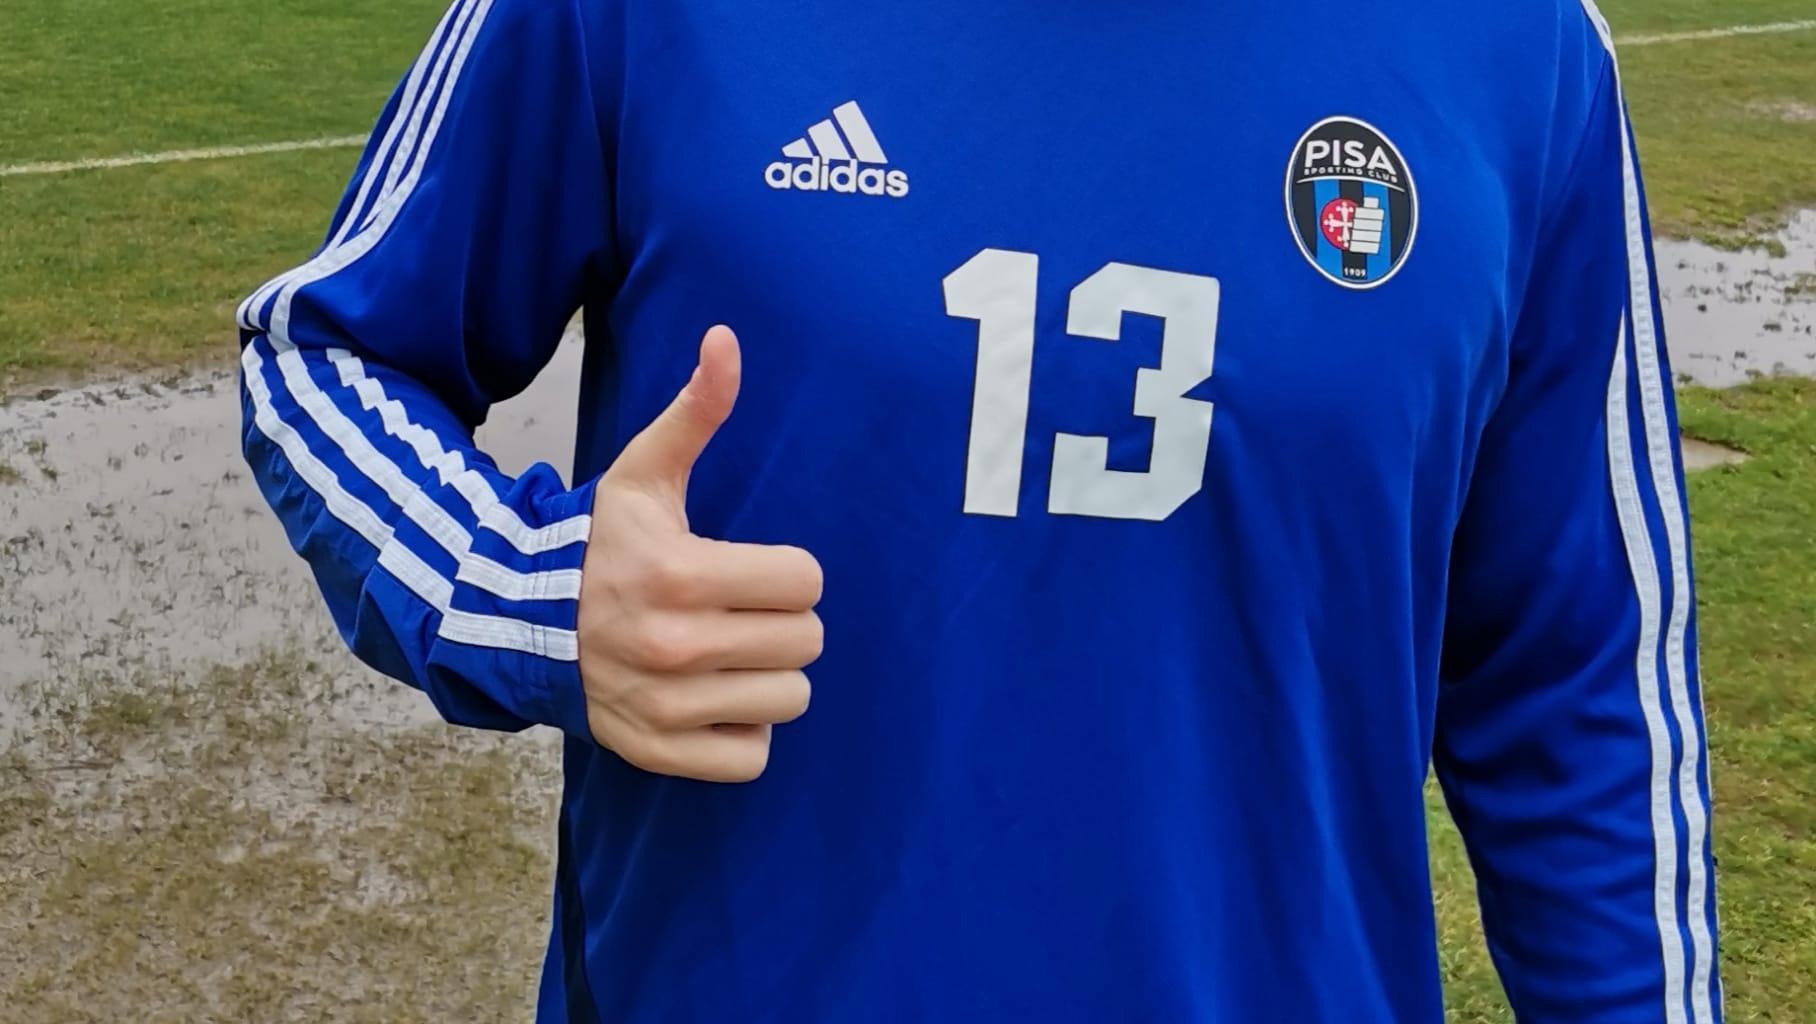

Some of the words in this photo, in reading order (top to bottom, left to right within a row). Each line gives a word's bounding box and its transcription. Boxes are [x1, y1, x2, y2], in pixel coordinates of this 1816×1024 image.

[1303, 166, 1364, 176] SPORTING
[1368, 170, 1398, 183] CLUB
[1304, 139, 1397, 175] PISA
[765, 156, 909, 197] adidas
[1343, 267, 1366, 277] 1909
[942, 247, 1220, 521] 13
